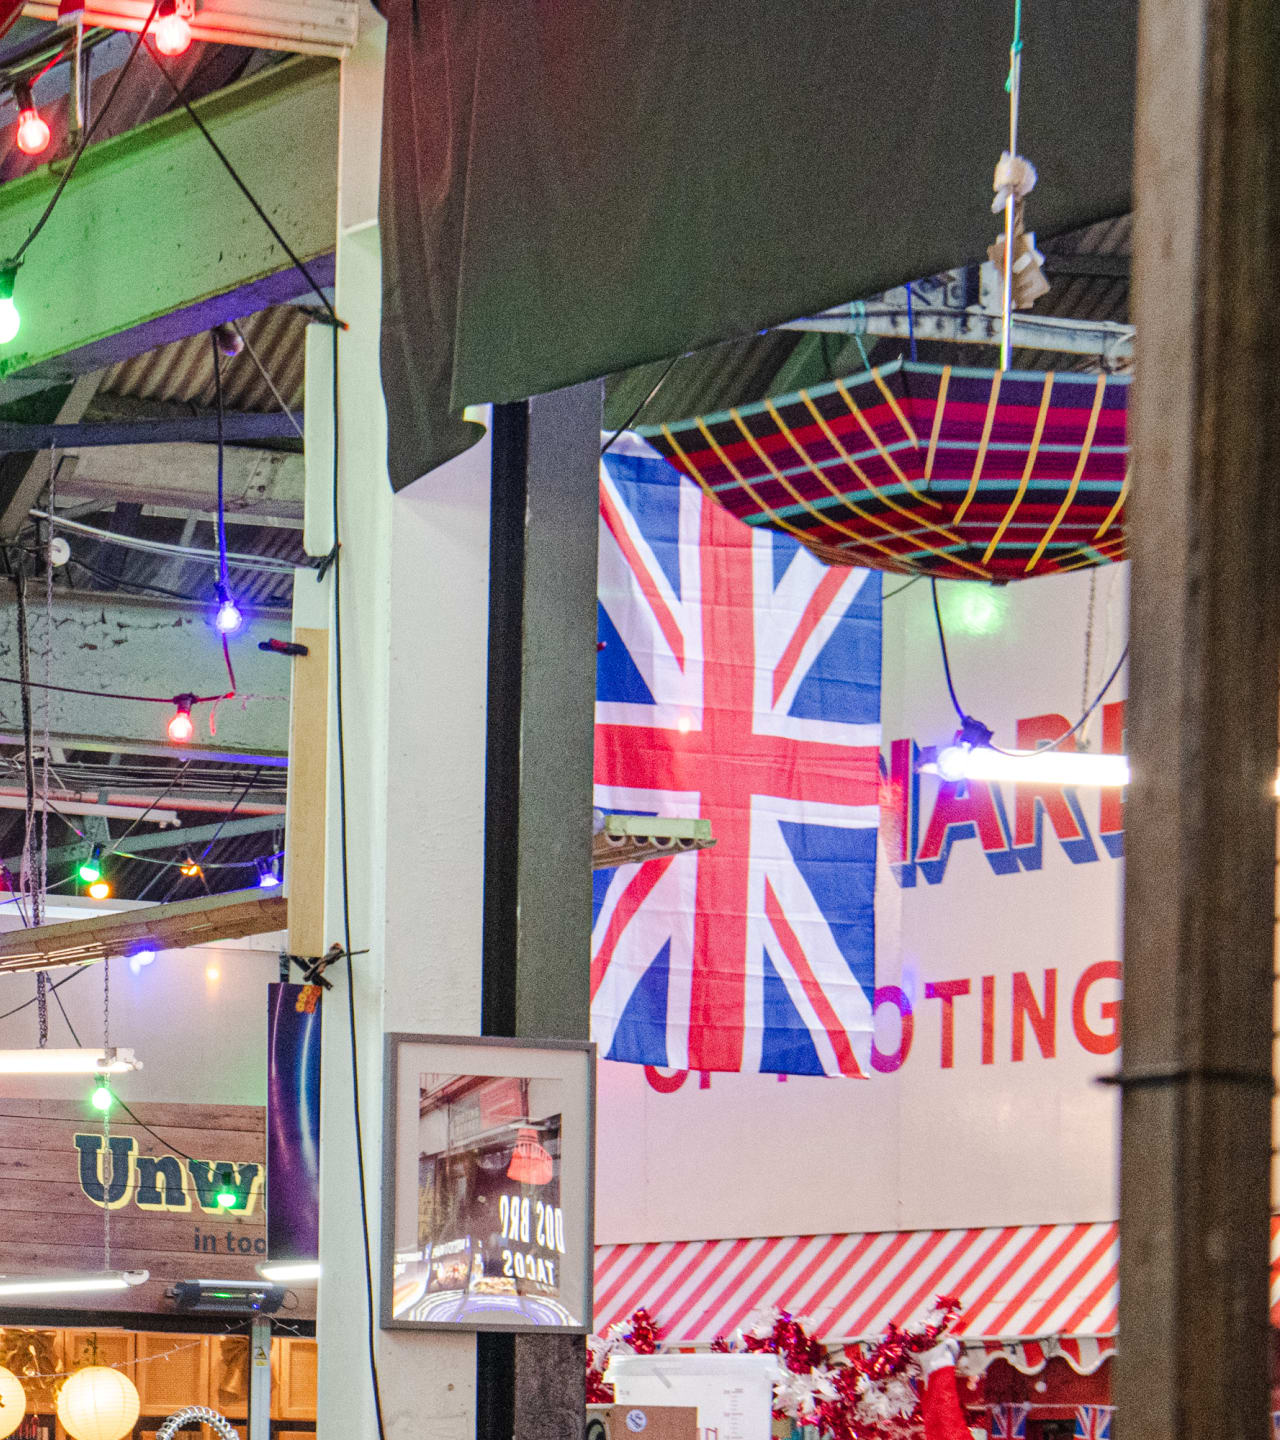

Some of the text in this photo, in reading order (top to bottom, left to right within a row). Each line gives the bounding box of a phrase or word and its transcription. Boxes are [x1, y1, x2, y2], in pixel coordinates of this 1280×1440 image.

[871, 960, 1122, 1074] OTING
[73, 1132, 266, 1216] Unw
[194, 1226, 266, 1255] in too
